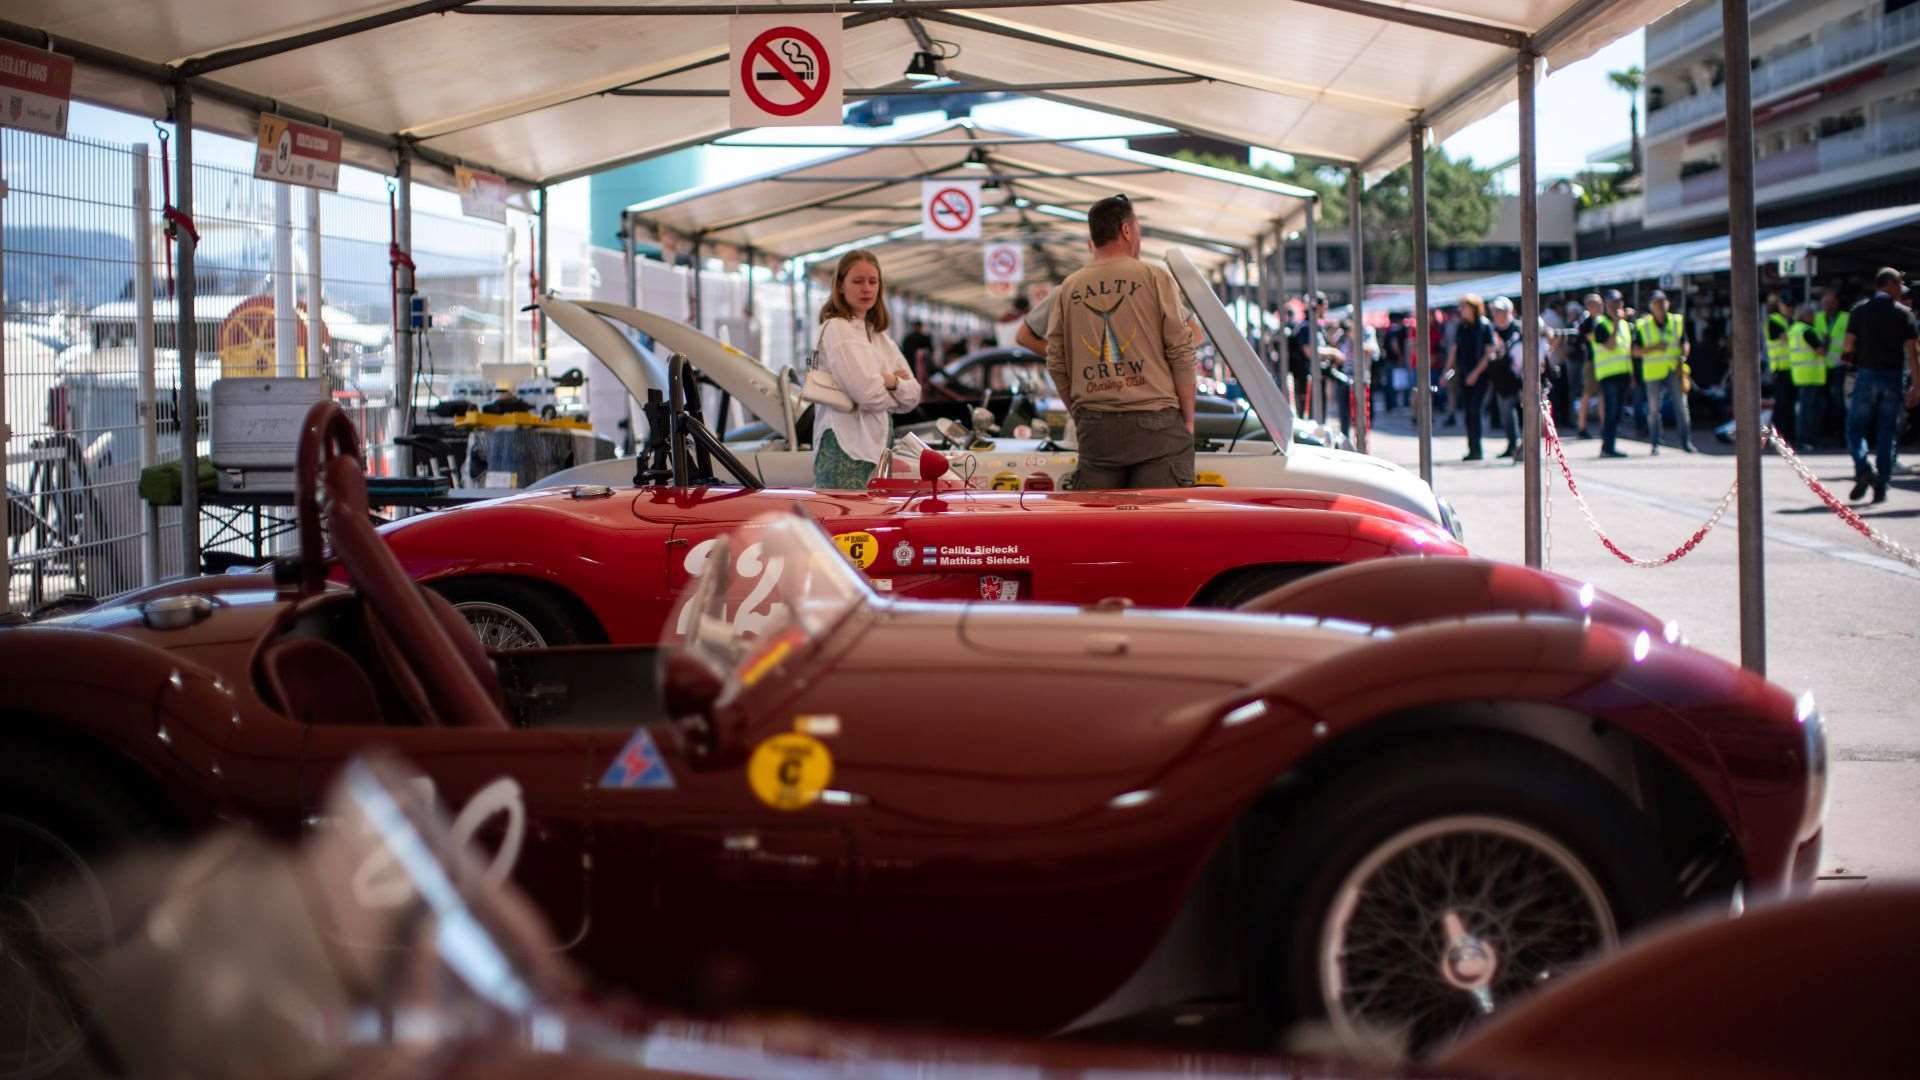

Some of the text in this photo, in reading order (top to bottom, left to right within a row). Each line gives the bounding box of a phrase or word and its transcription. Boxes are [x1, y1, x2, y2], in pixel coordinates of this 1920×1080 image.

[1071, 279, 1142, 305] SALTY
[1083, 360, 1144, 380] CREW
[850, 543, 864, 559] C
[975, 545, 1018, 554] Sielecki
[940, 555, 1030, 565] Mathias Sielecki
[777, 758, 802, 786] C
